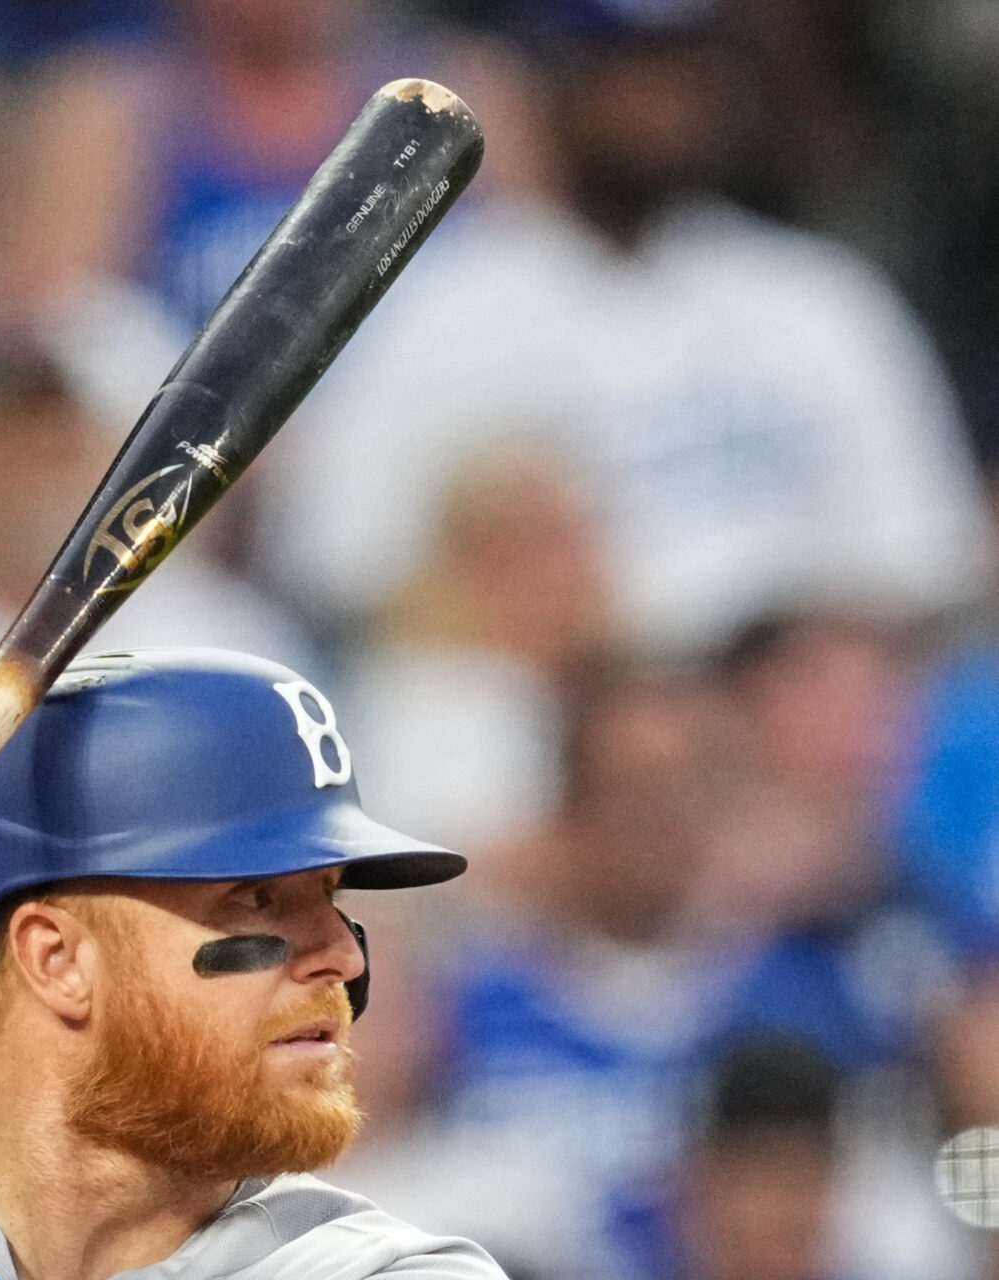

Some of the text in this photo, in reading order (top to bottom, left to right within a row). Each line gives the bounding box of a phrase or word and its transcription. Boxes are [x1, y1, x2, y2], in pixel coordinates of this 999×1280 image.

[393, 139, 421, 169] T181
[346, 183, 386, 233] GENUINE
[376, 251, 393, 276] LOS
[417, 176, 450, 225] DODGERS
[273, 681, 352, 788] B
